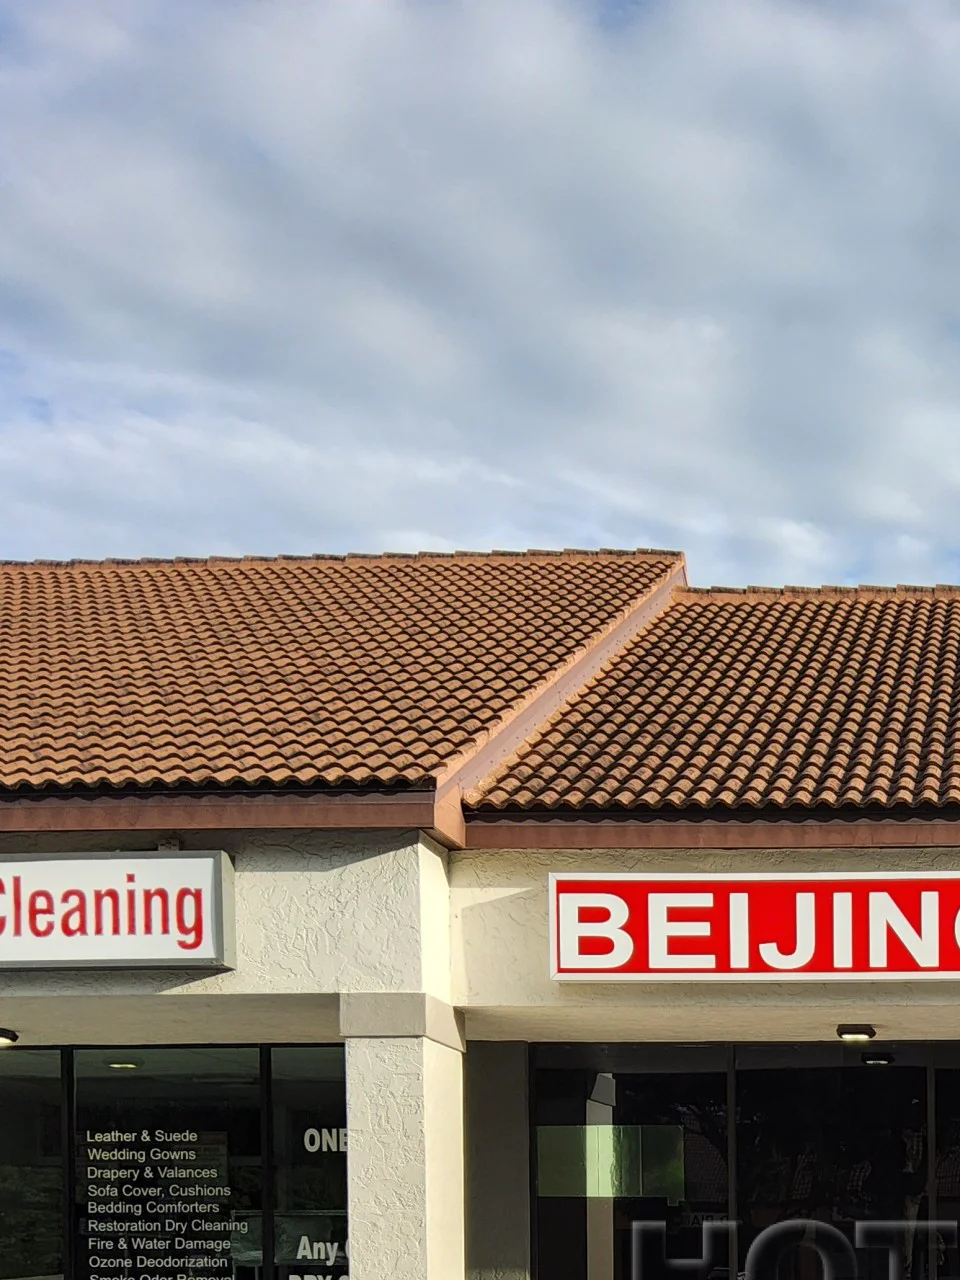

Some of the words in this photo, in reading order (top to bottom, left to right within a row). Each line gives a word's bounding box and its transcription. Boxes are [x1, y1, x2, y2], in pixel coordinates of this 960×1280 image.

[0, 873, 203, 950] leaning
[86, 1130, 137, 1143] Leather
[140, 1130, 151, 1142] &
[154, 1130, 198, 1143] Suede
[87, 1148, 146, 1163] Wedding
[150, 1148, 196, 1161] Gowns
[87, 1166, 140, 1181] Drapery
[144, 1166, 154, 1178] &
[157, 1166, 218, 1179] Valances
[87, 1184, 118, 1197] Sofa
[122, 1184, 165, 1198] Cover,
[169, 1184, 231, 1197] Cushions
[87, 1201, 142, 1216] Bedding
[146, 1201, 220, 1214] Comforters
[88, 1219, 161, 1232] Restoration
[165, 1220, 188, 1234] Dry
[191, 1219, 248, 1234] Cleaning
[88, 1238, 114, 1250] Fire
[118, 1238, 128, 1250] &
[131, 1238, 171, 1250] Water
[174, 1238, 231, 1252] Damage
[296, 1235, 339, 1267] Any
[88, 1256, 132, 1268] Ozone
[136, 1255, 228, 1268] Deodorization
